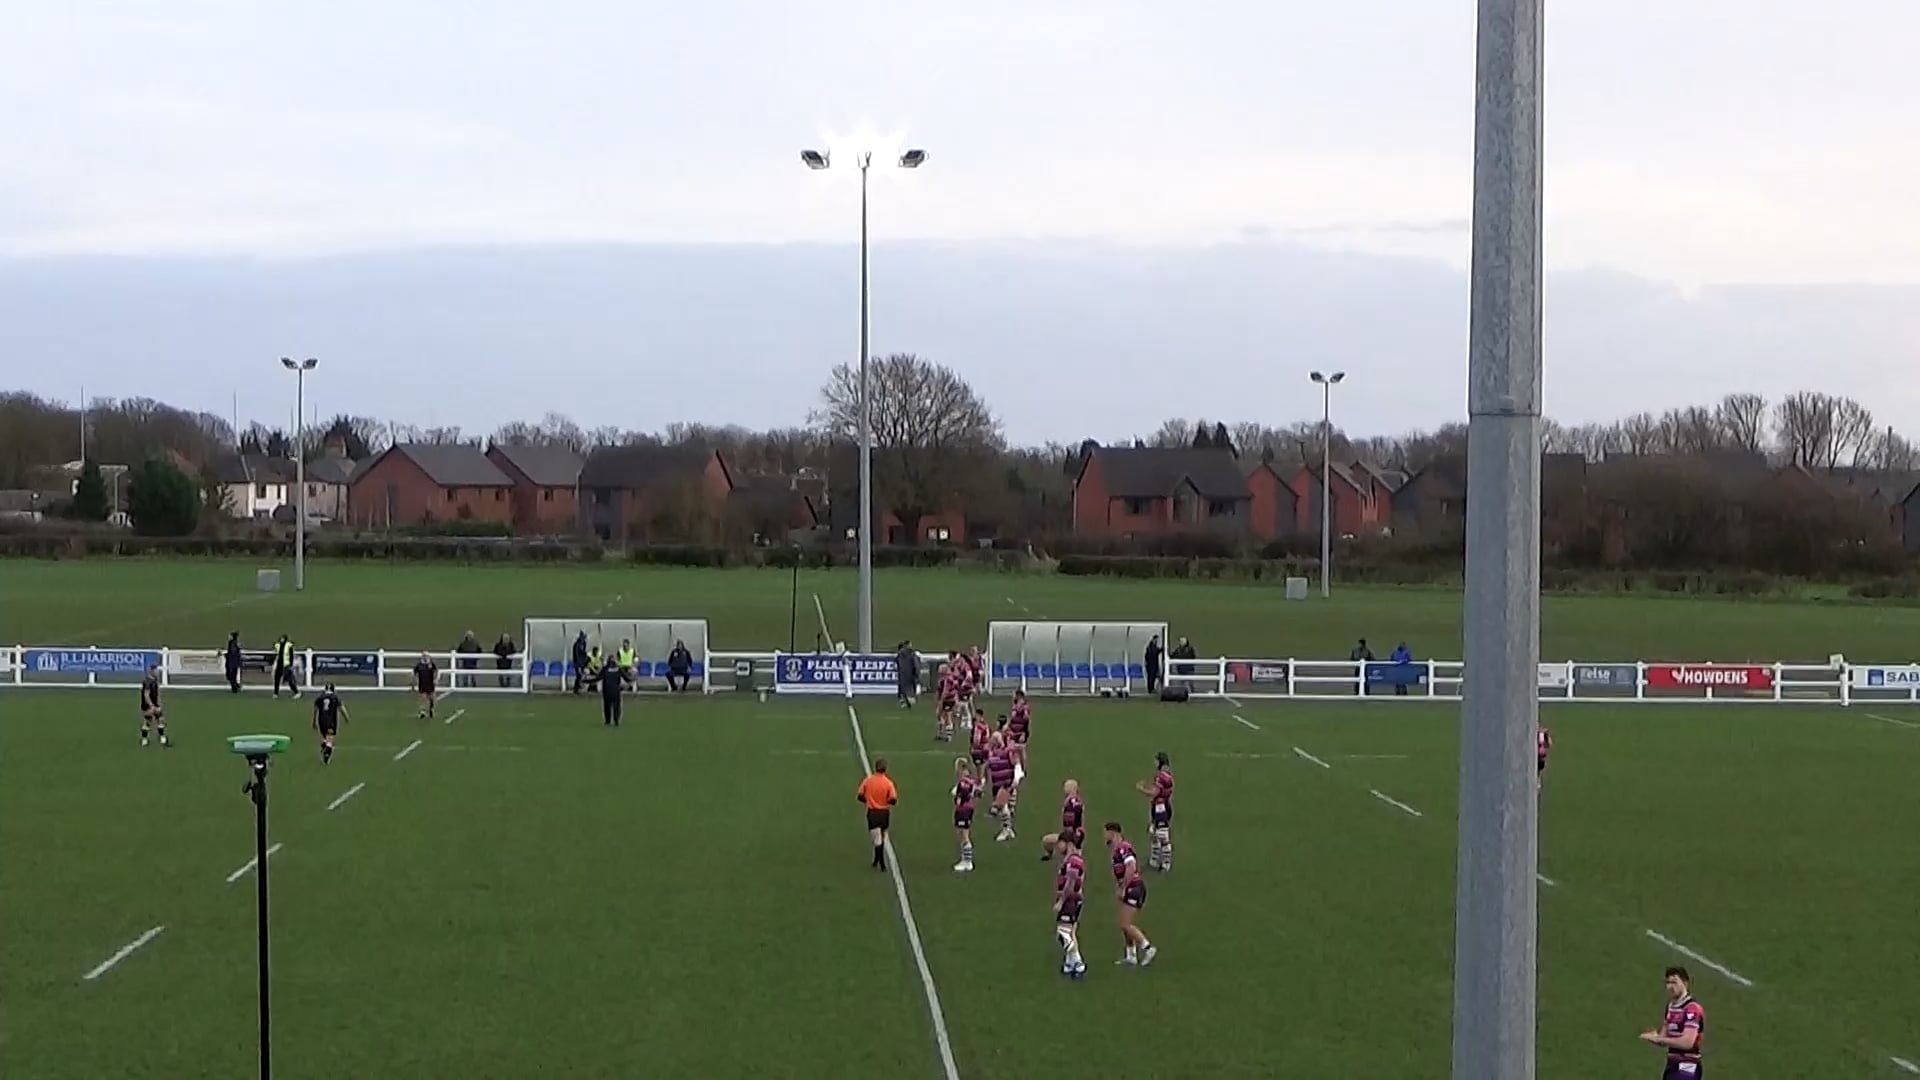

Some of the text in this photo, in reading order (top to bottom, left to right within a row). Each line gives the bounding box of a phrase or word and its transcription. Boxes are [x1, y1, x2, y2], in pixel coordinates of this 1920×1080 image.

[813, 671, 898, 681] OUR EFEREE
[1684, 670, 1748, 684] HOWDENS
